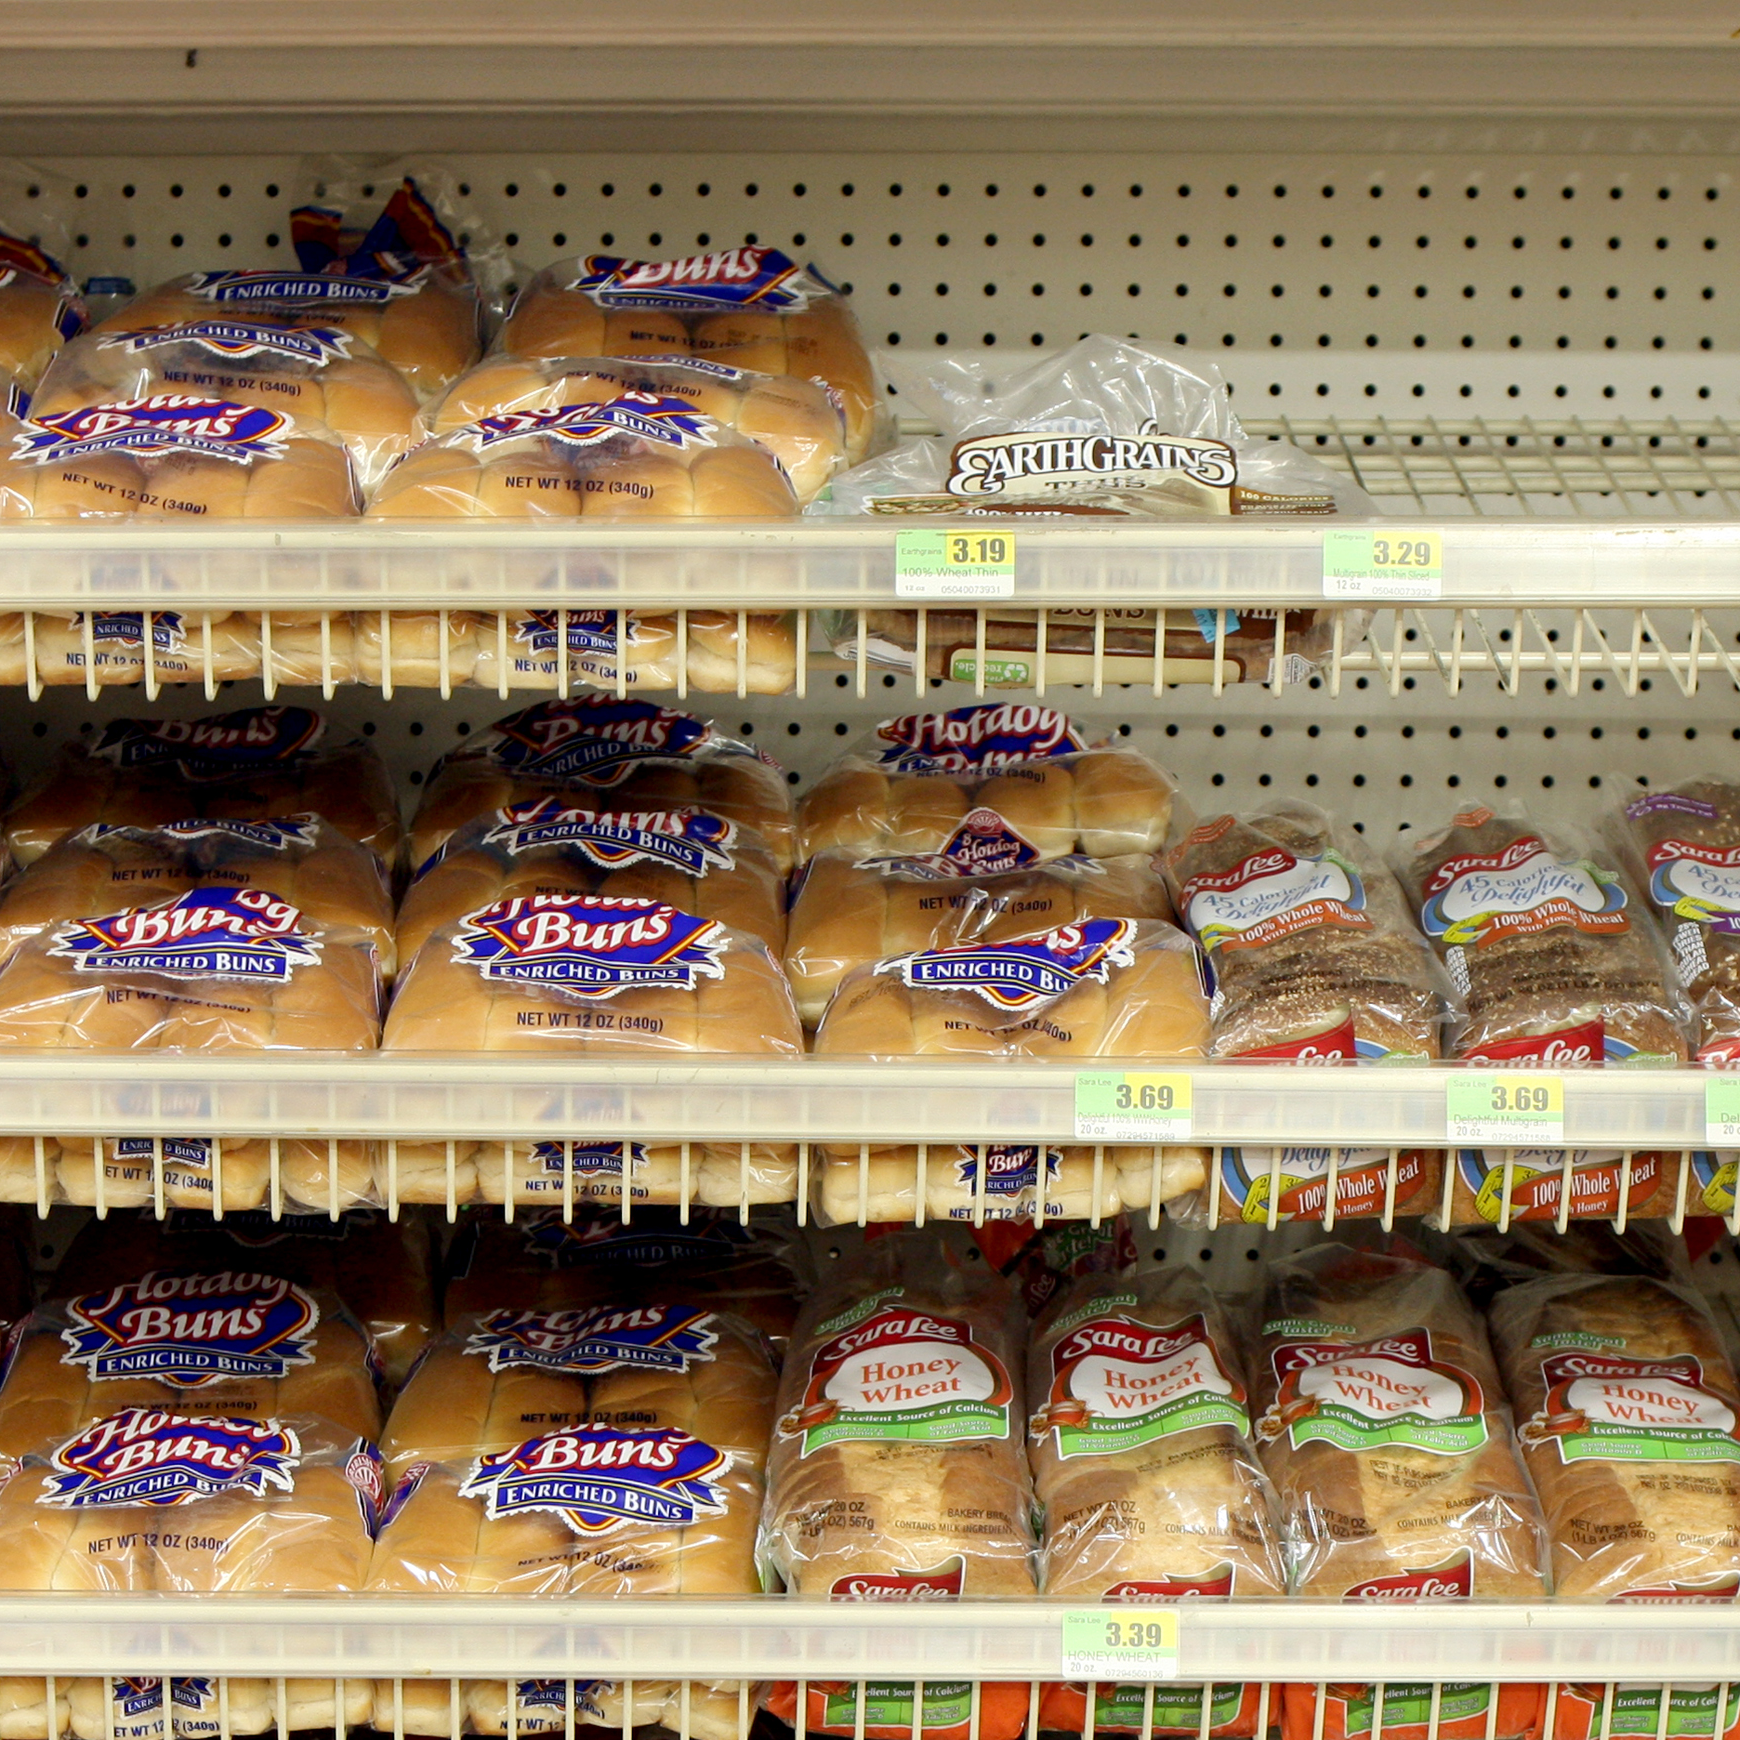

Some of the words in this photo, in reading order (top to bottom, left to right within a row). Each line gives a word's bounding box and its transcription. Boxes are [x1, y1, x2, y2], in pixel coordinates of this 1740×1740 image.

[946, 436, 1237, 496] EARTHGRAINS
[506, 476, 533, 490] NET
[538, 477, 560, 490] WT
[565, 478, 582, 491] 12
[585, 480, 605, 493] OZ
[610, 481, 655, 500] (340g)
[901, 547, 942, 557] Earthgrains
[953, 537, 1005, 563] 3.19
[1373, 540, 1431, 566] 3.29
[903, 566, 932, 577] 100%
[936, 566, 972, 577] Wheat
[975, 566, 998, 577] Thin
[903, 704, 1066, 751] Hotdog
[519, 906, 667, 955] Buns
[500, 963, 611, 982] ENRICHED
[619, 966, 680, 981] BUNS
[1116, 1084, 1174, 1110] 3.69
[1492, 1086, 1548, 1111] 3.69
[1454, 1114, 1496, 1127] Delightful
[1724, 1125, 1734, 1134] 20
[861, 1358, 960, 1384] Honey
[862, 1378, 960, 1404] Wheat
[1106, 1622, 1161, 1647] 3.39
[1068, 1651, 1110, 1661] HONEY
[1115, 1652, 1160, 1662] WHEAT
